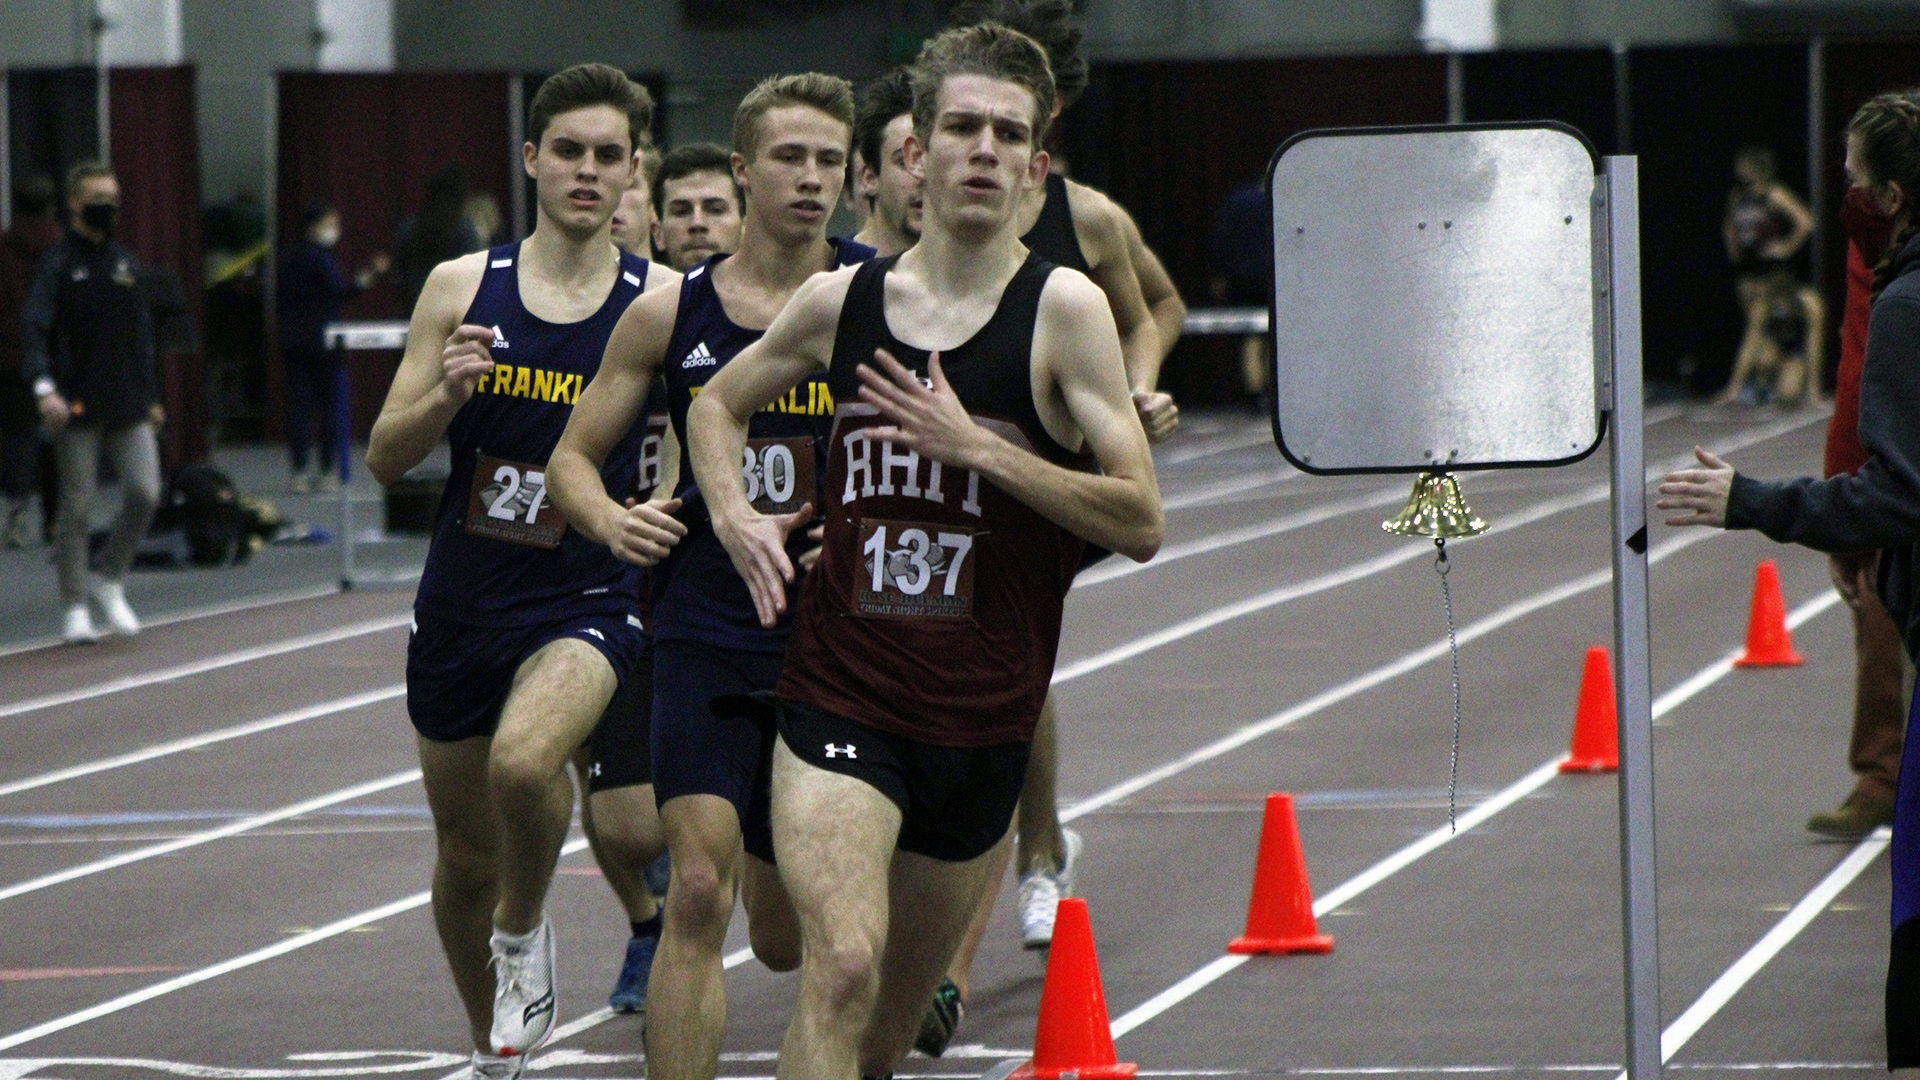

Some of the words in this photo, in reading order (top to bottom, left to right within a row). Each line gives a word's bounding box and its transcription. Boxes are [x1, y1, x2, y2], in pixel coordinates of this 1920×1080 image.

[682, 357, 717, 369] adidas
[487, 466, 546, 524] 27
[864, 526, 972, 596] 137
